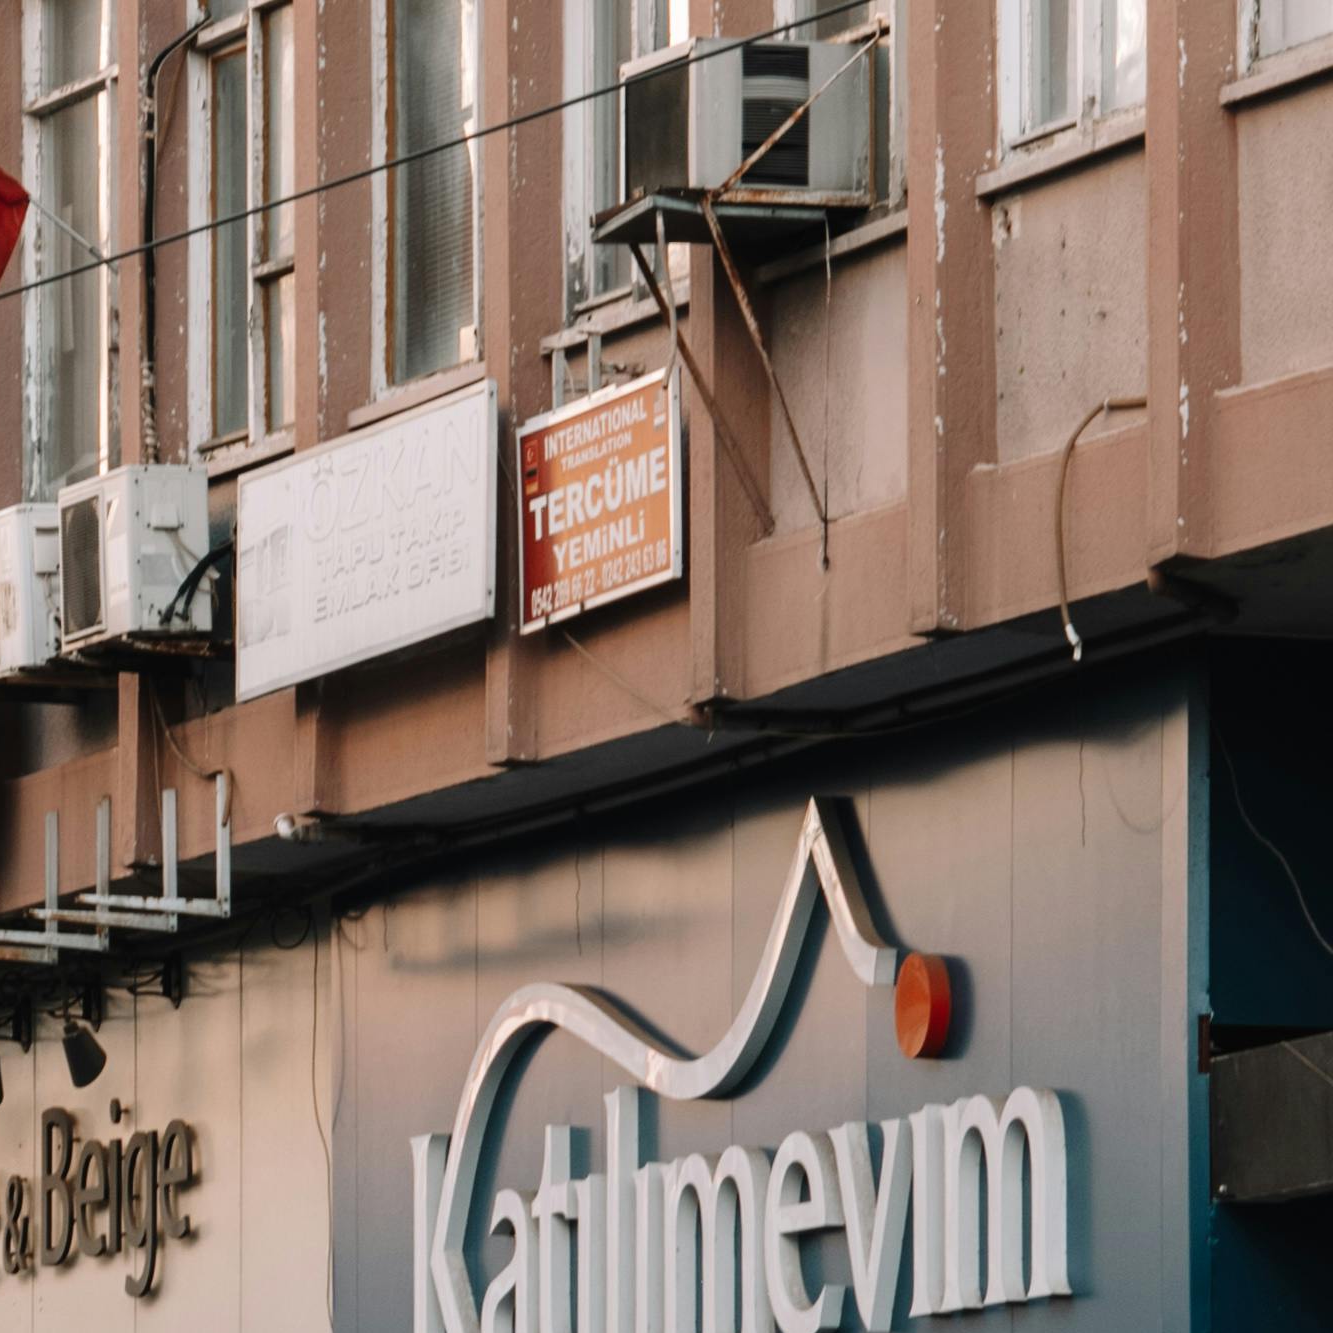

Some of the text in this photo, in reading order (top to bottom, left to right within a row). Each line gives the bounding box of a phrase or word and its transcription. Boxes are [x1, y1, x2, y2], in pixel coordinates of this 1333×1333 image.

[544, 397, 648, 462] INTERNATIONAL
[560, 431, 632, 472] TRANSLATION
[529, 445, 667, 541] TERCÜME
[4, 1175, 35, 1274] &
[41, 1098, 197, 1298] Beige
